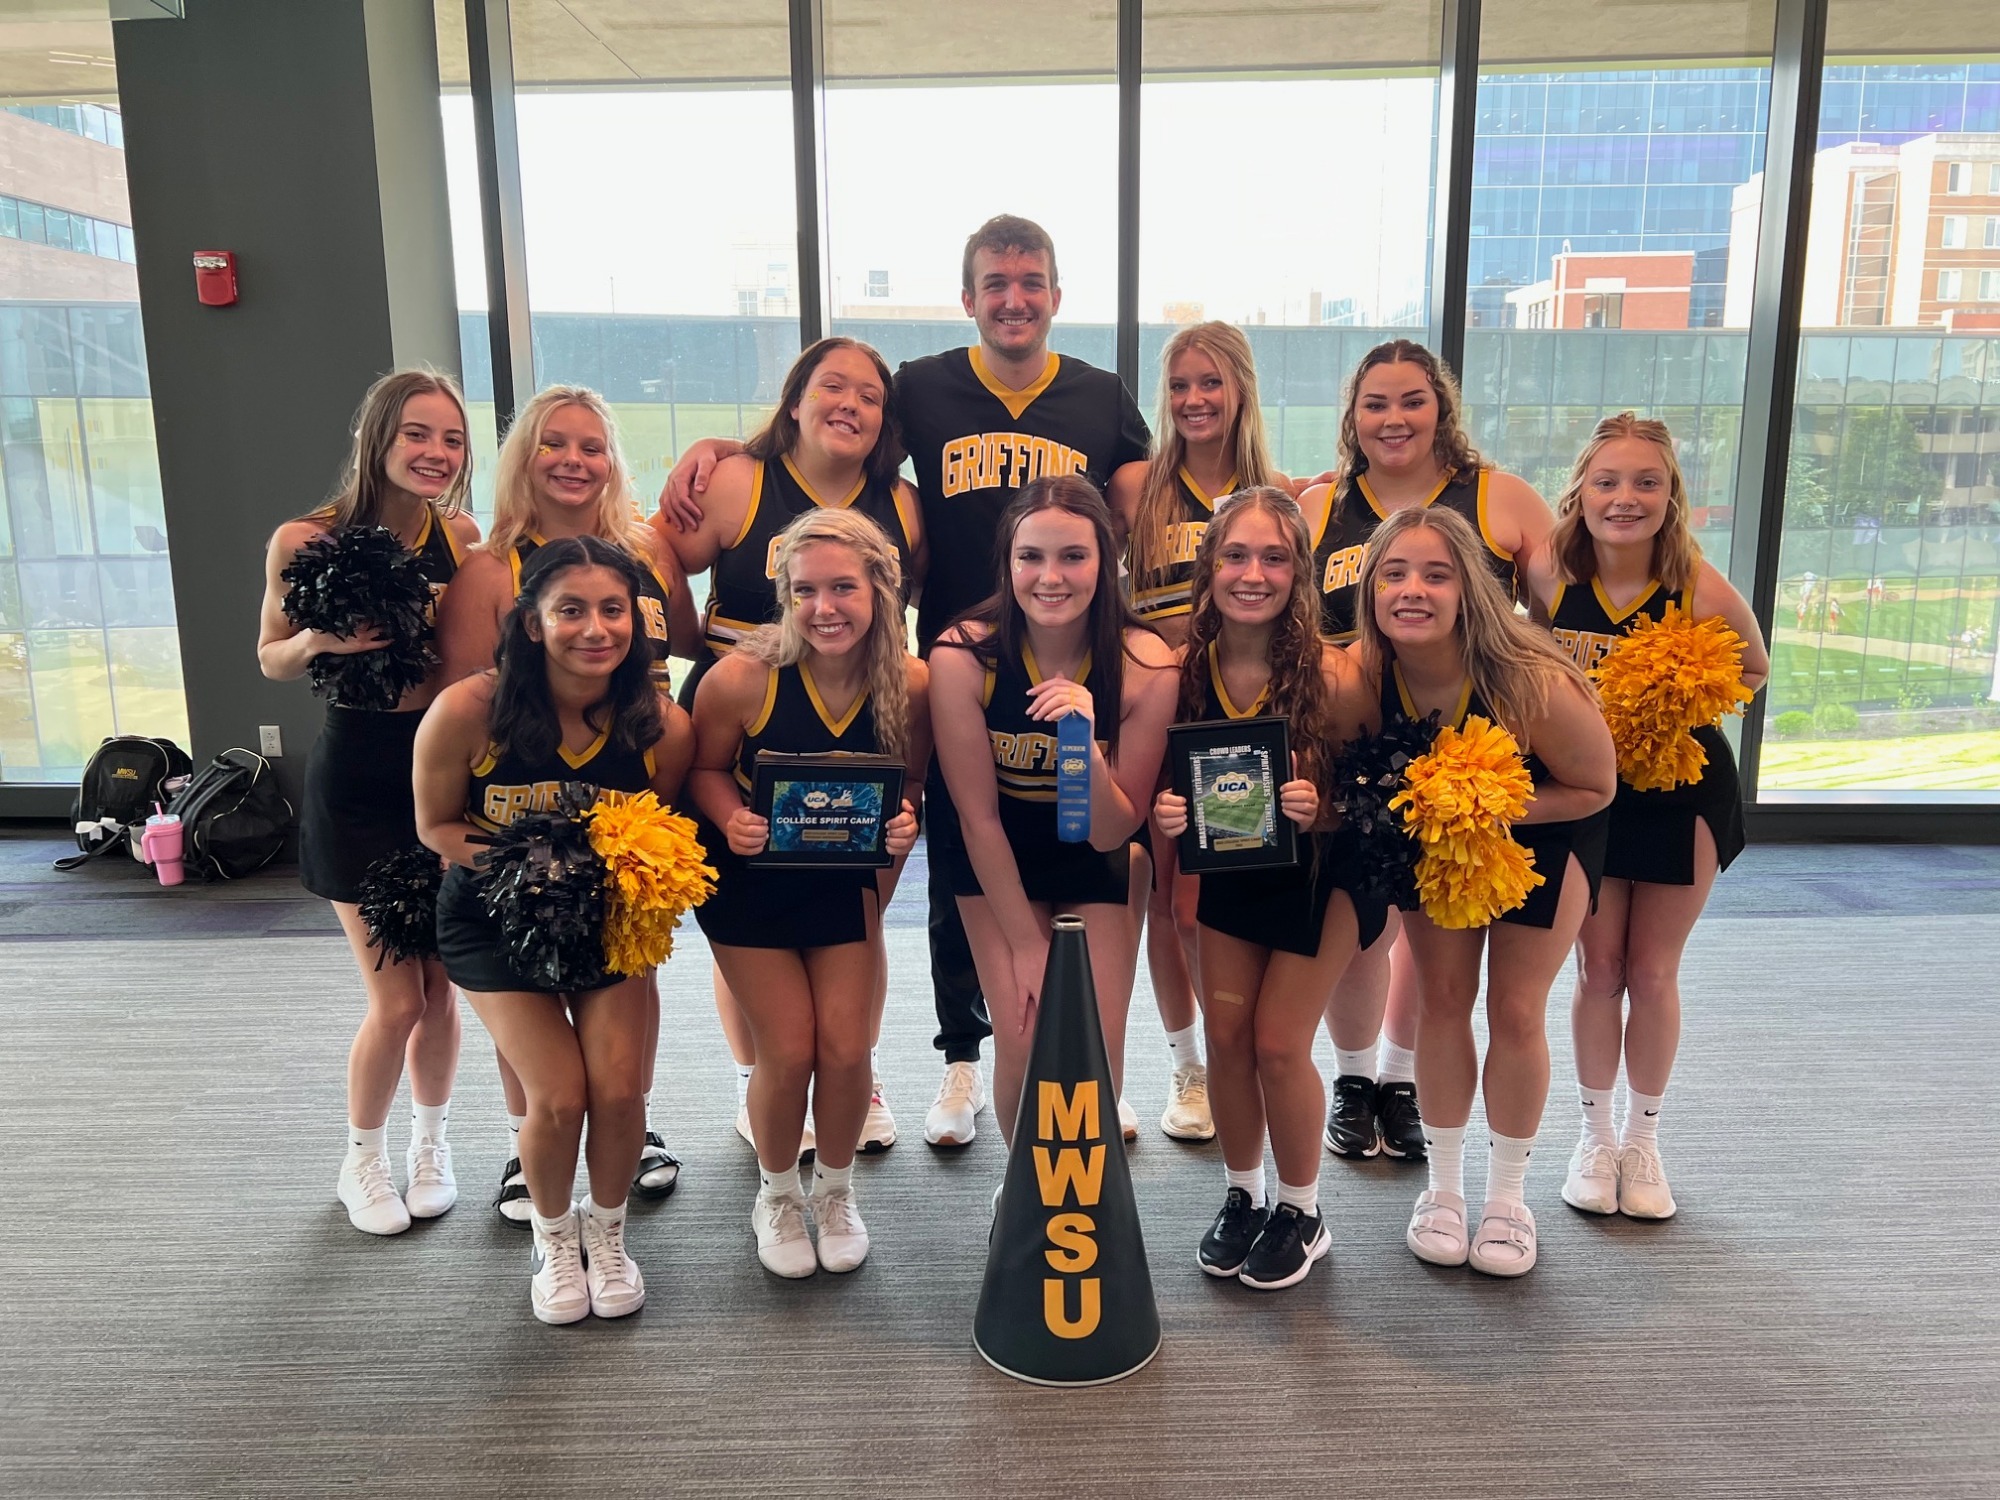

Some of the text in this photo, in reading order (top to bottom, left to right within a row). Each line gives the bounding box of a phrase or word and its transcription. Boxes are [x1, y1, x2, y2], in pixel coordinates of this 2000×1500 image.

[1229, 745, 1251, 754] LEADERS
[1217, 782, 1248, 793] UCA
[776, 816, 876, 825] COLLEGE SPIRIT CAMP
[1032, 1079, 1107, 1339] MWSU
